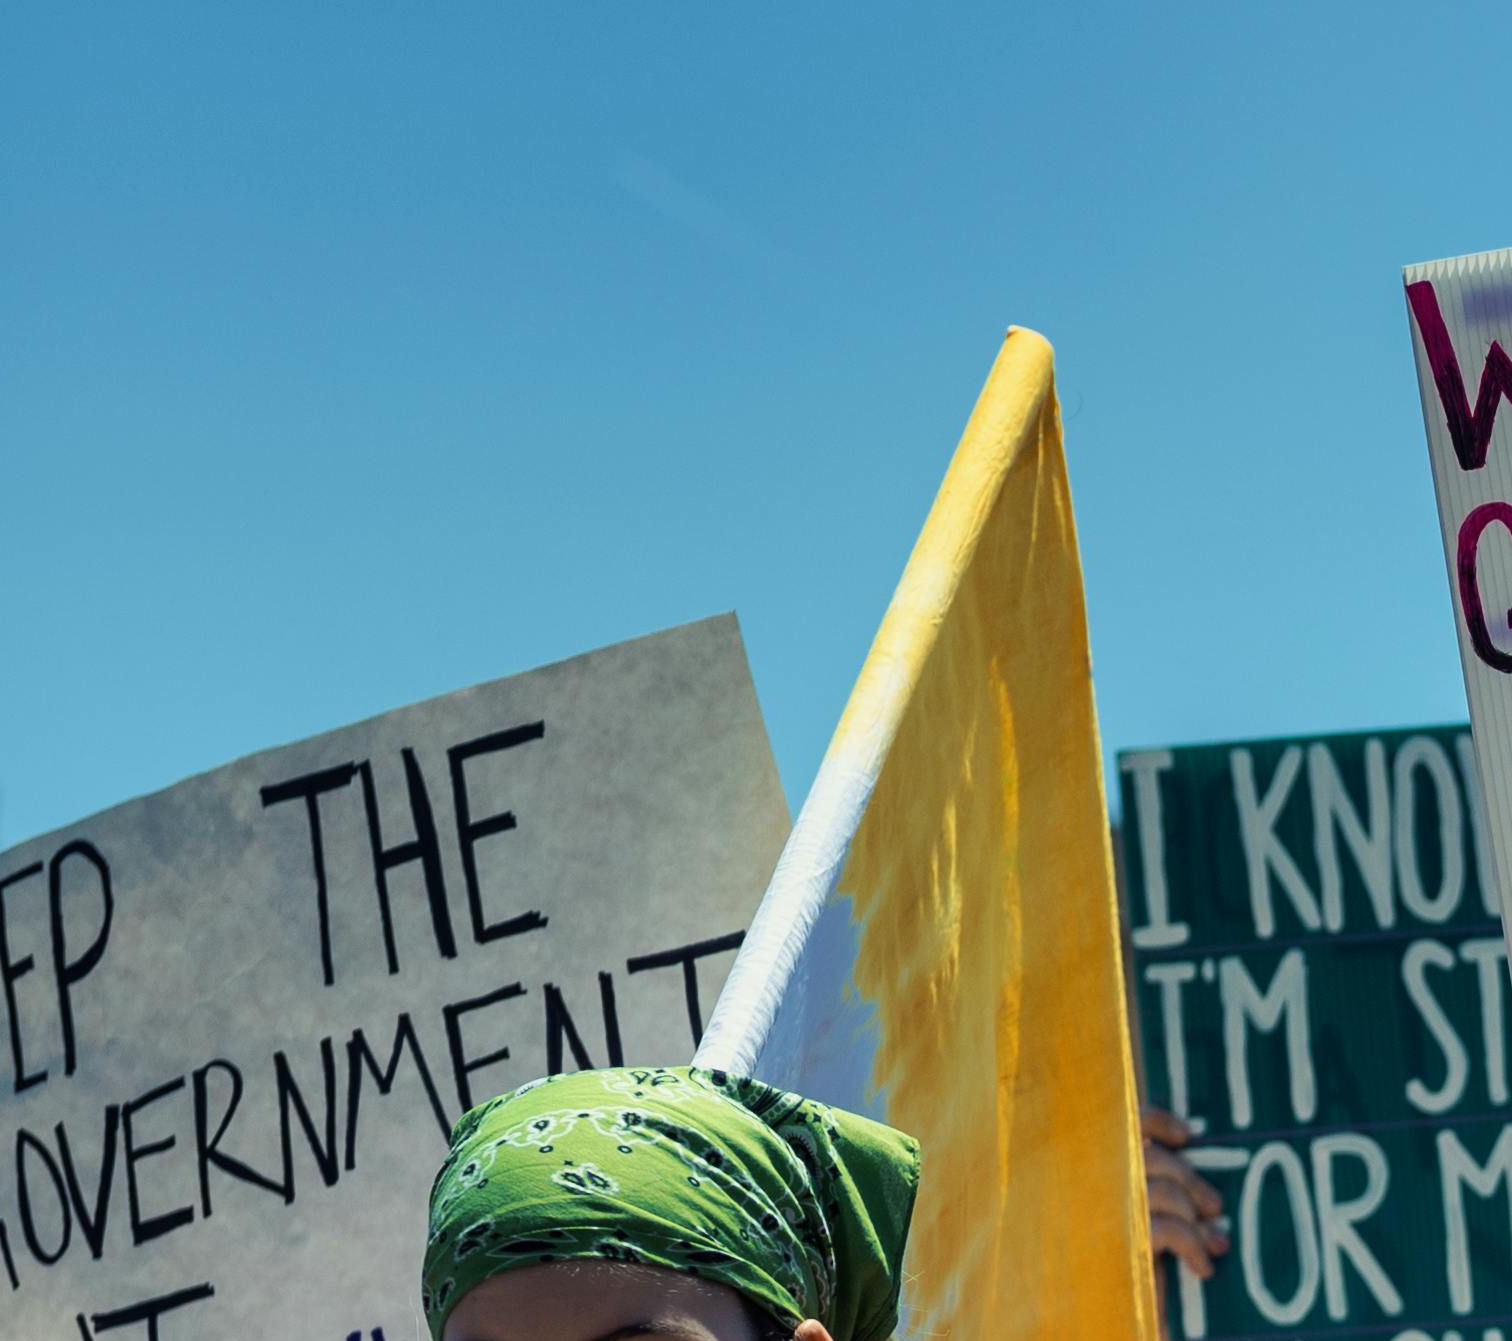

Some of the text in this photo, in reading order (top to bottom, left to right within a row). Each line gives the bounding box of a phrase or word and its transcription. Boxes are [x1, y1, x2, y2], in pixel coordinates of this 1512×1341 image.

[261, 720, 549, 985] THE
[1121, 734, 1503, 948] I KNO
[1145, 949, 1318, 1135] I'M
[1178, 1133, 1403, 1340] FOR
